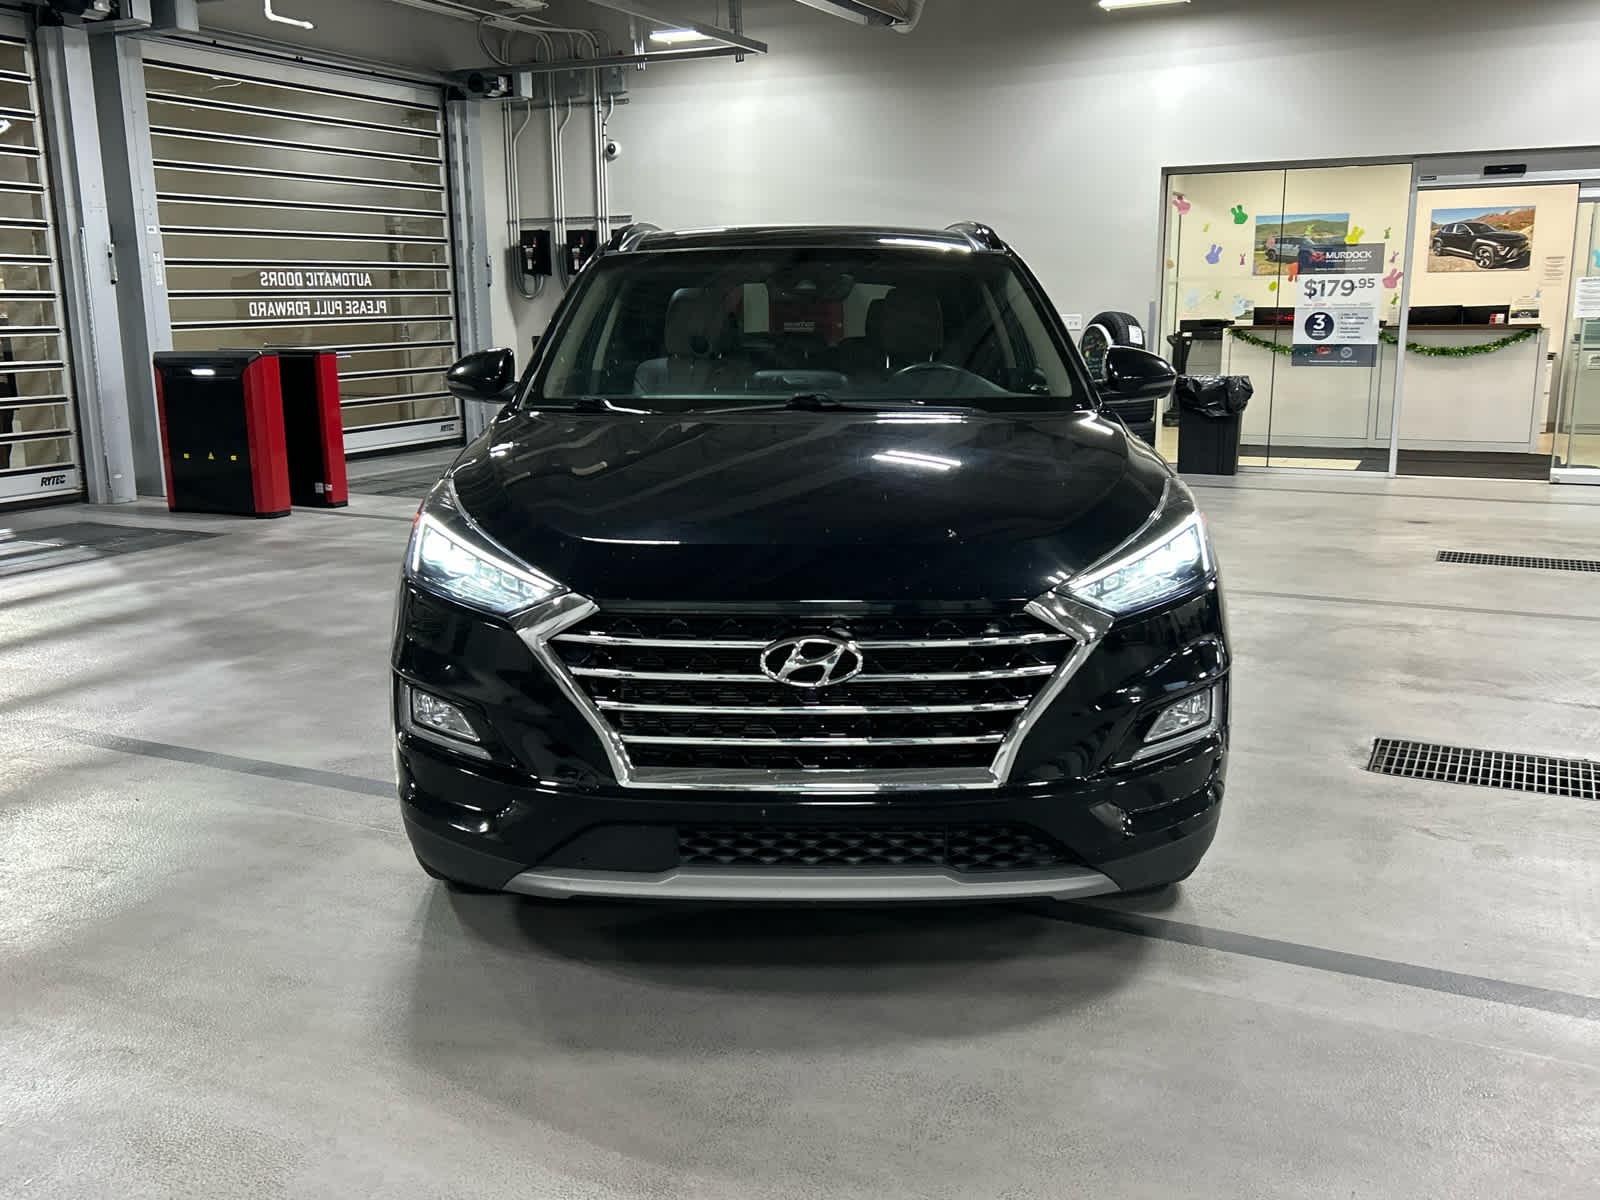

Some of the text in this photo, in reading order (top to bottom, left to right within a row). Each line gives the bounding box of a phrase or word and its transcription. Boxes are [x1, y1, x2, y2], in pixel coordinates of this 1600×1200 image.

[1325, 251, 1372, 259] MURDOCK
[1304, 278, 1375, 299] $179.95
[1312, 314, 1326, 330] 3
[40, 474, 66, 487] RYTEC
